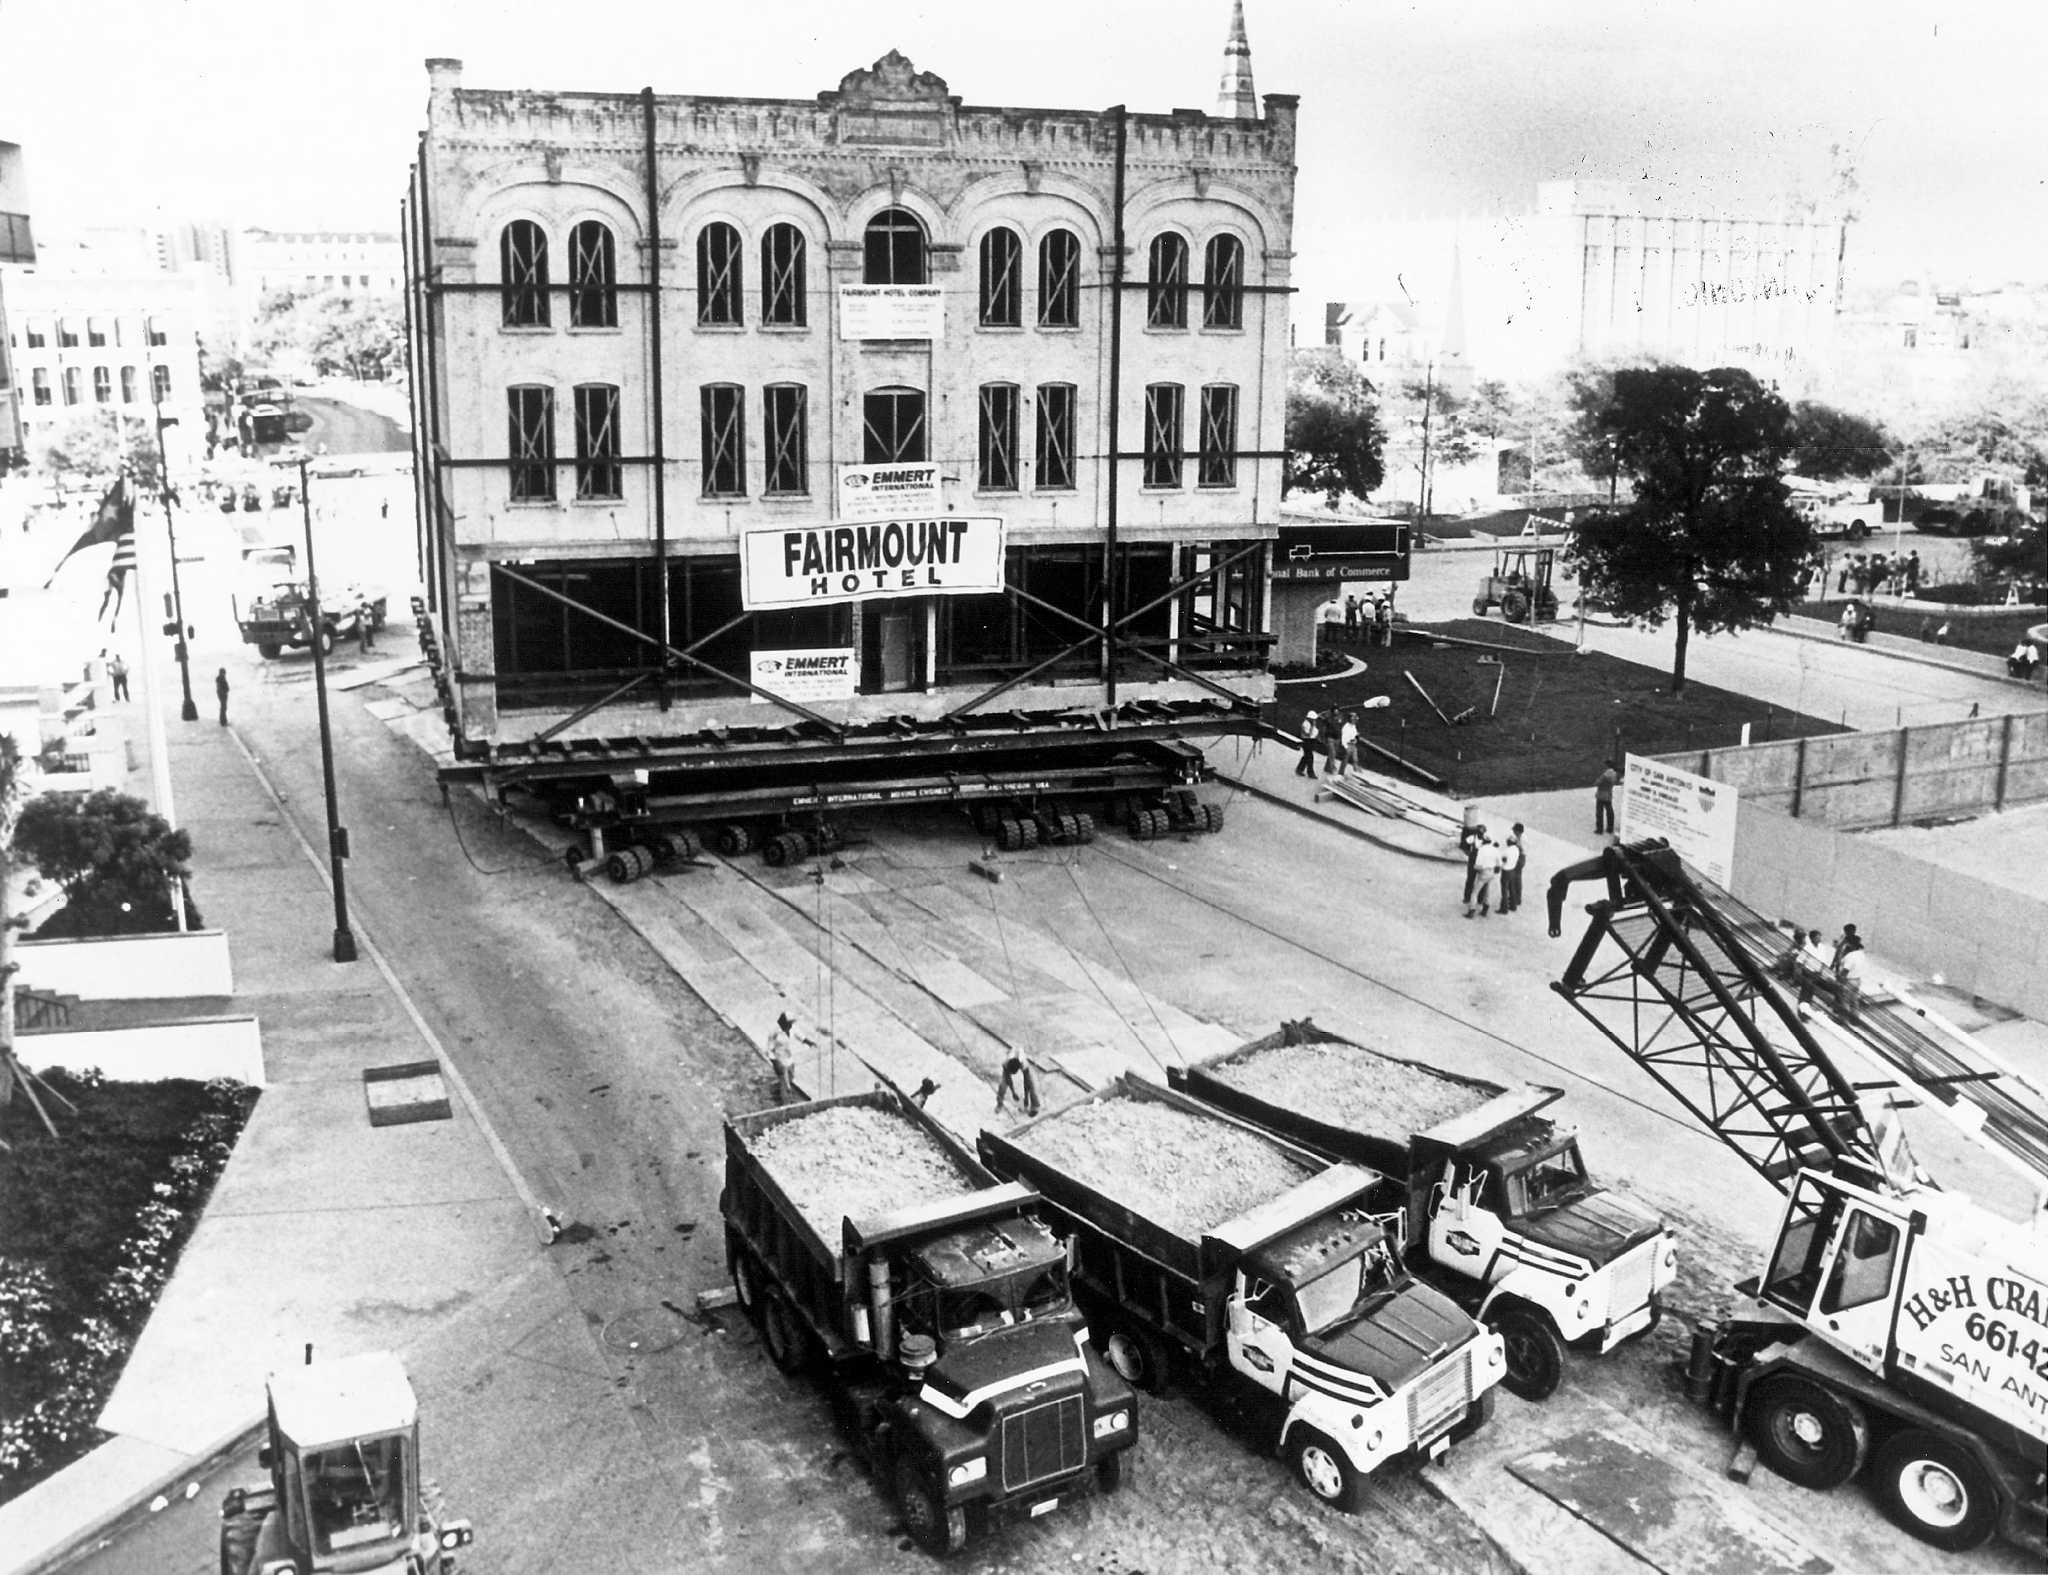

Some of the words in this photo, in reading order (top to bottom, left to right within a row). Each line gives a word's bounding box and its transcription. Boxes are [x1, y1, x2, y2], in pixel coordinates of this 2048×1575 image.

[841, 287, 881, 297] FAIRMOUNT
[884, 288, 905, 297] HOTEL
[908, 288, 941, 297] COMPANY
[872, 469, 936, 484] EMMERT
[871, 483, 935, 491] INTERNATIONAL
[784, 521, 968, 577] FAIRMOUNT
[1296, 568, 1320, 578] Bank
[1326, 567, 1337, 577] of
[1340, 566, 1391, 577] Commerce
[811, 567, 942, 595] HOTEL
[786, 656, 849, 670] EMMERT
[784, 669, 848, 677] INTERNATIONAL
[1903, 1275, 1977, 1331] H&H
[1940, 1343, 1990, 1383] SAN
[2000, 1376, 2048, 1415] ANT
